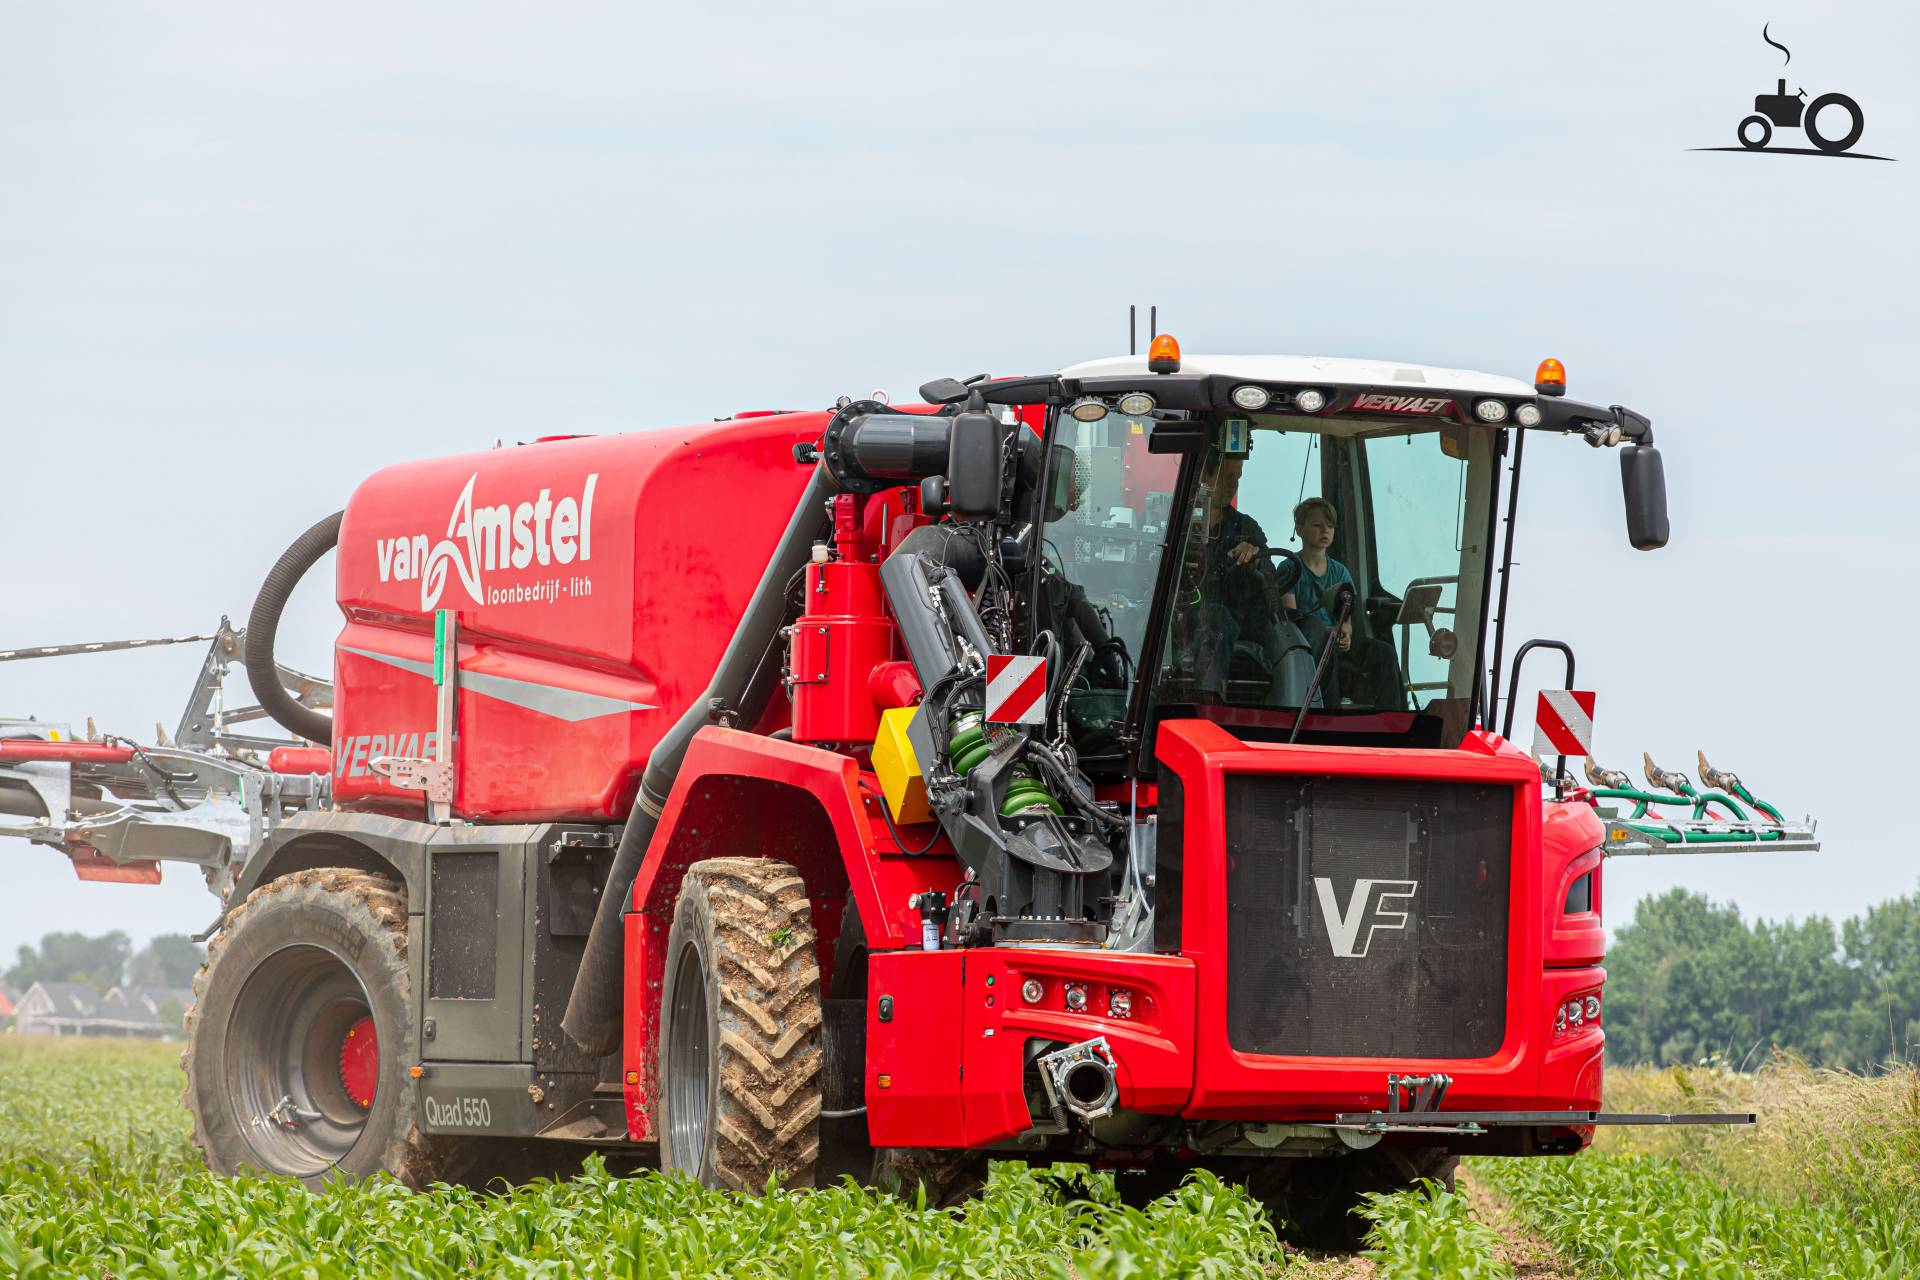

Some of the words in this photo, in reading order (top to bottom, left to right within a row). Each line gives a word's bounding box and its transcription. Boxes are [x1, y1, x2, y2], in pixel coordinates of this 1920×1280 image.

[1353, 393, 1453, 413] VERVAET
[376, 533, 430, 583] van
[421, 471, 599, 613] Amstel
[487, 579, 560, 606] loonbedrijf
[570, 576, 592, 597] lith
[336, 731, 457, 785] VERVAE
[1314, 877, 1418, 957] VF
[425, 1096, 462, 1127] Quad
[463, 1098, 491, 1127] 550
